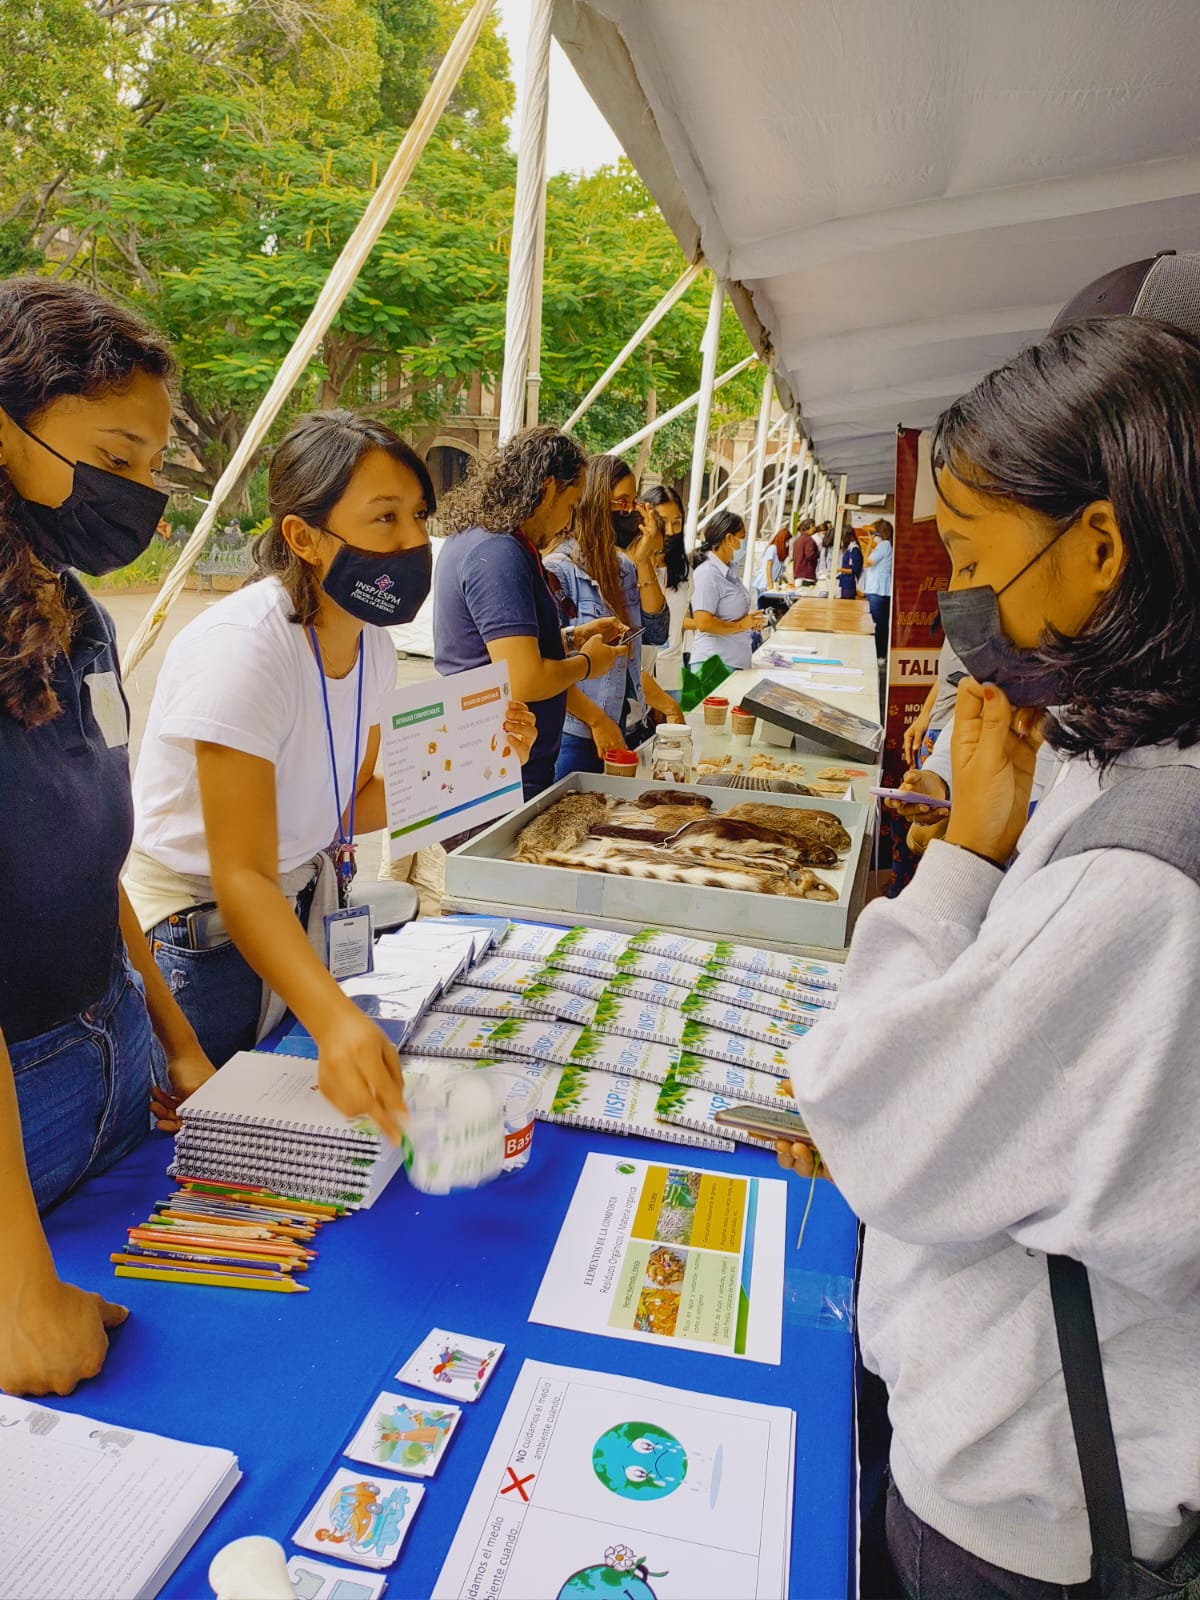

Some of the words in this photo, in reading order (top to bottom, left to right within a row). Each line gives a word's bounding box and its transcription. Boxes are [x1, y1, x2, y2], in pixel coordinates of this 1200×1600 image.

[355, 580, 401, 605] INSP/ESPM
[920, 577, 948, 591] JUE
[603, 1074, 632, 1119] INSPiral
[596, 1236, 606, 1245] DE
[599, 1228, 608, 1236] LA
[584, 1245, 603, 1286] ELEMENTOS
[516, 1449, 527, 1463] NO
[522, 1412, 540, 1449] cuidamos
[536, 1403, 542, 1412] el
[539, 1382, 551, 1404] medio
[534, 1424, 552, 1460] ambiente
[465, 1561, 488, 1600] idamos
[482, 1548, 492, 1559] el
[487, 1516, 504, 1547] medio
